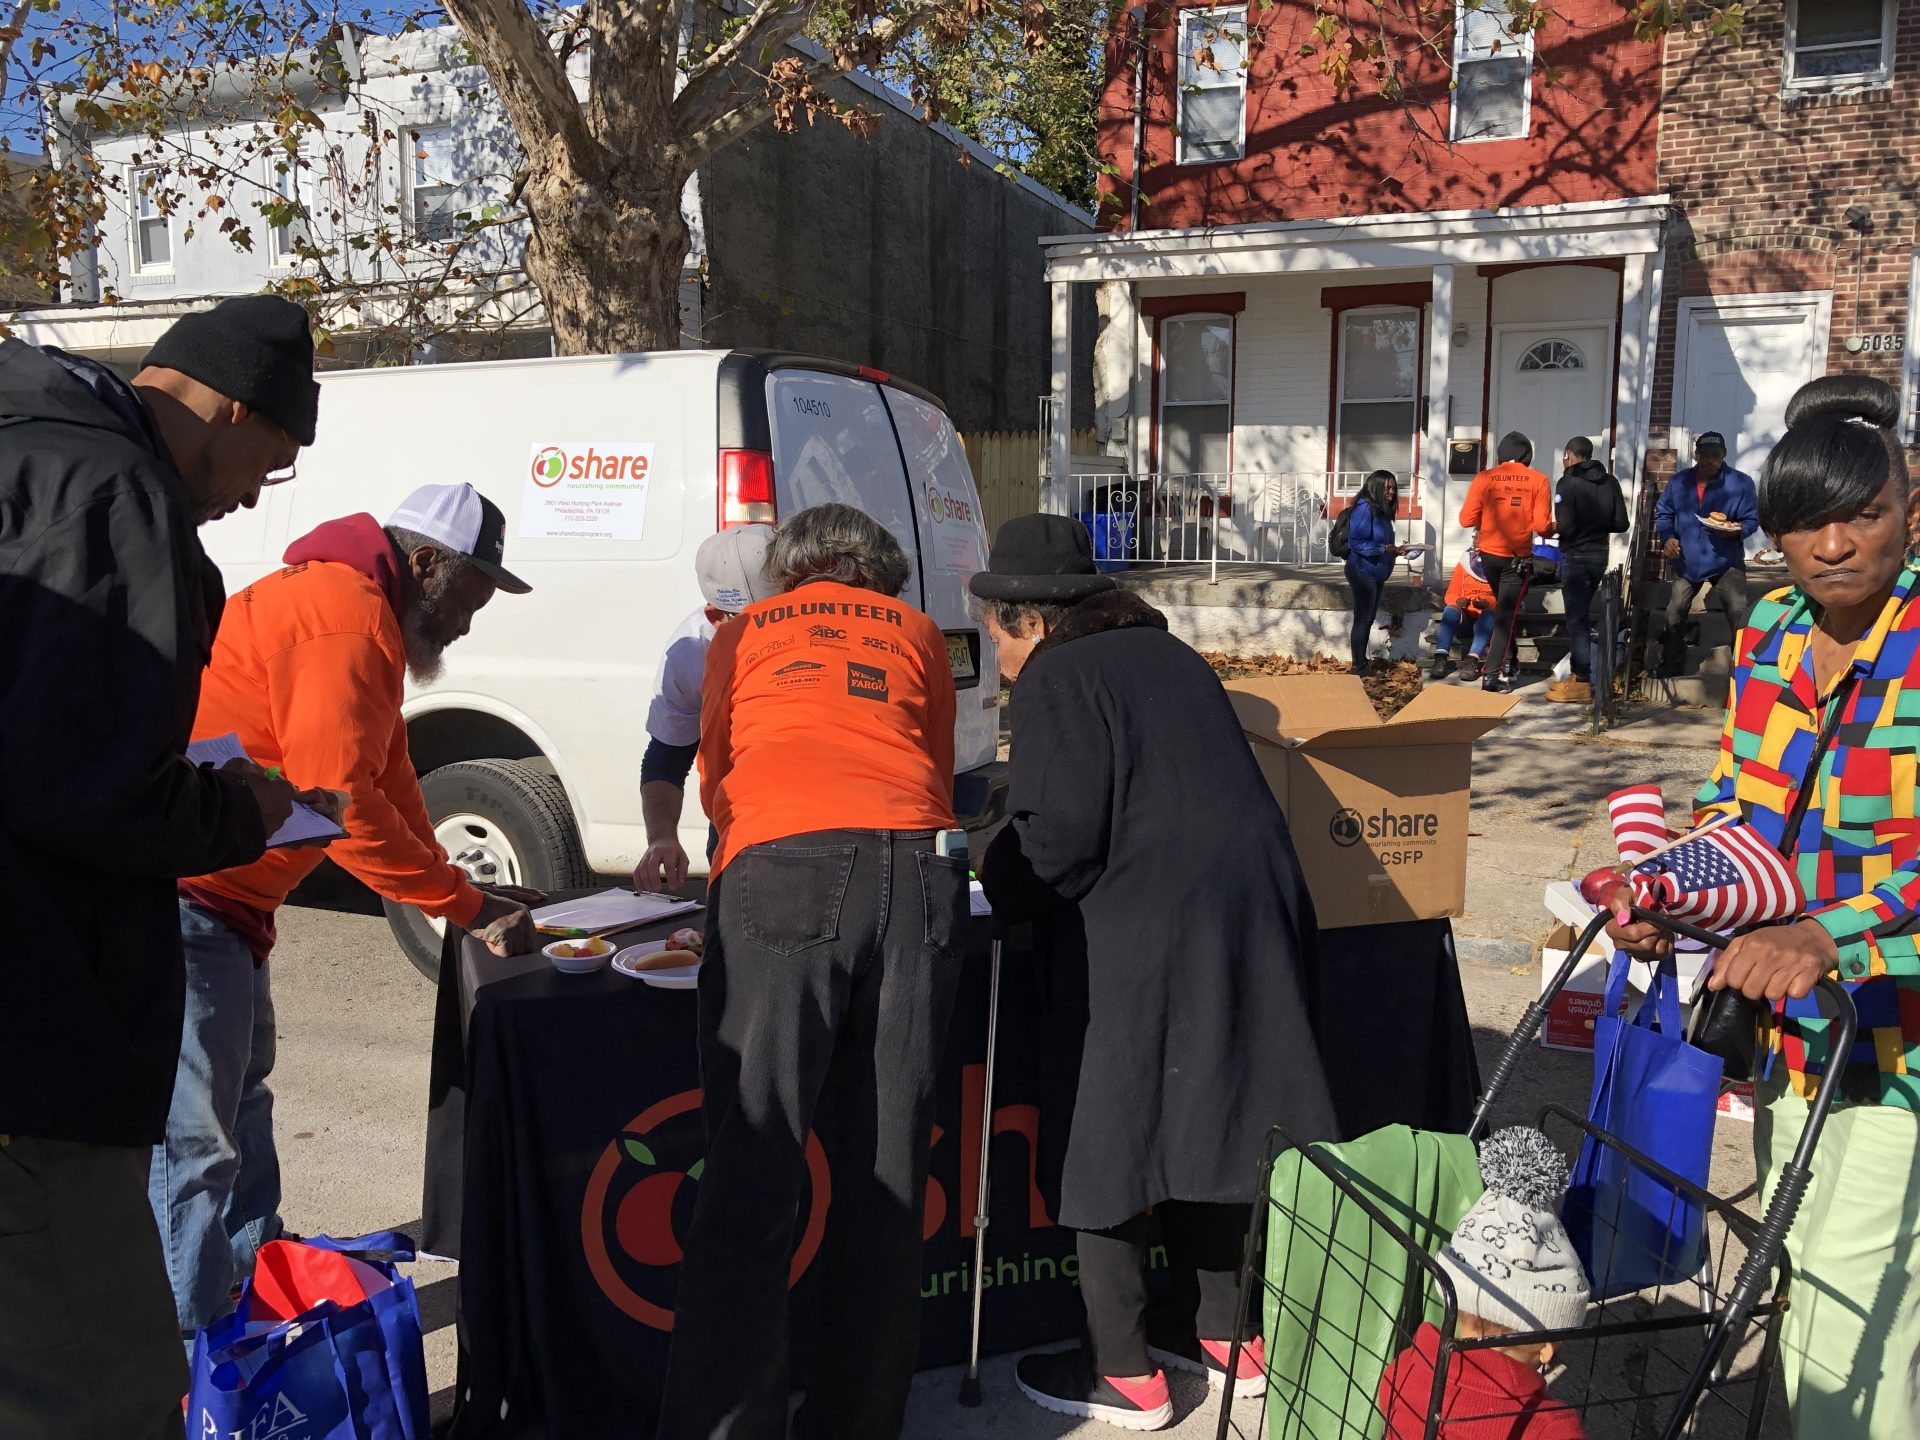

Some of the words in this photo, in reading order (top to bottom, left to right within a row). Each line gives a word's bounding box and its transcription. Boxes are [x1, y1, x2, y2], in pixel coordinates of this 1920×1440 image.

[1861, 335, 1904, 351] 6035
[793, 397, 831, 418] 104510
[568, 447, 649, 480] share
[1490, 474, 1530, 483] VOLUNTEER
[567, 483, 604, 491] nourishing
[605, 483, 645, 491] community
[943, 491, 971, 522] share
[752, 602, 903, 629] VOLUNTEER
[809, 626, 848, 640] ABC
[850, 679, 887, 692] FARGO
[1367, 807, 1439, 838] share
[1366, 840, 1401, 848] nourishing
[1402, 838, 1437, 846] community
[1379, 850, 1424, 865] CSFP
[920, 1250, 1080, 1298] urishing
